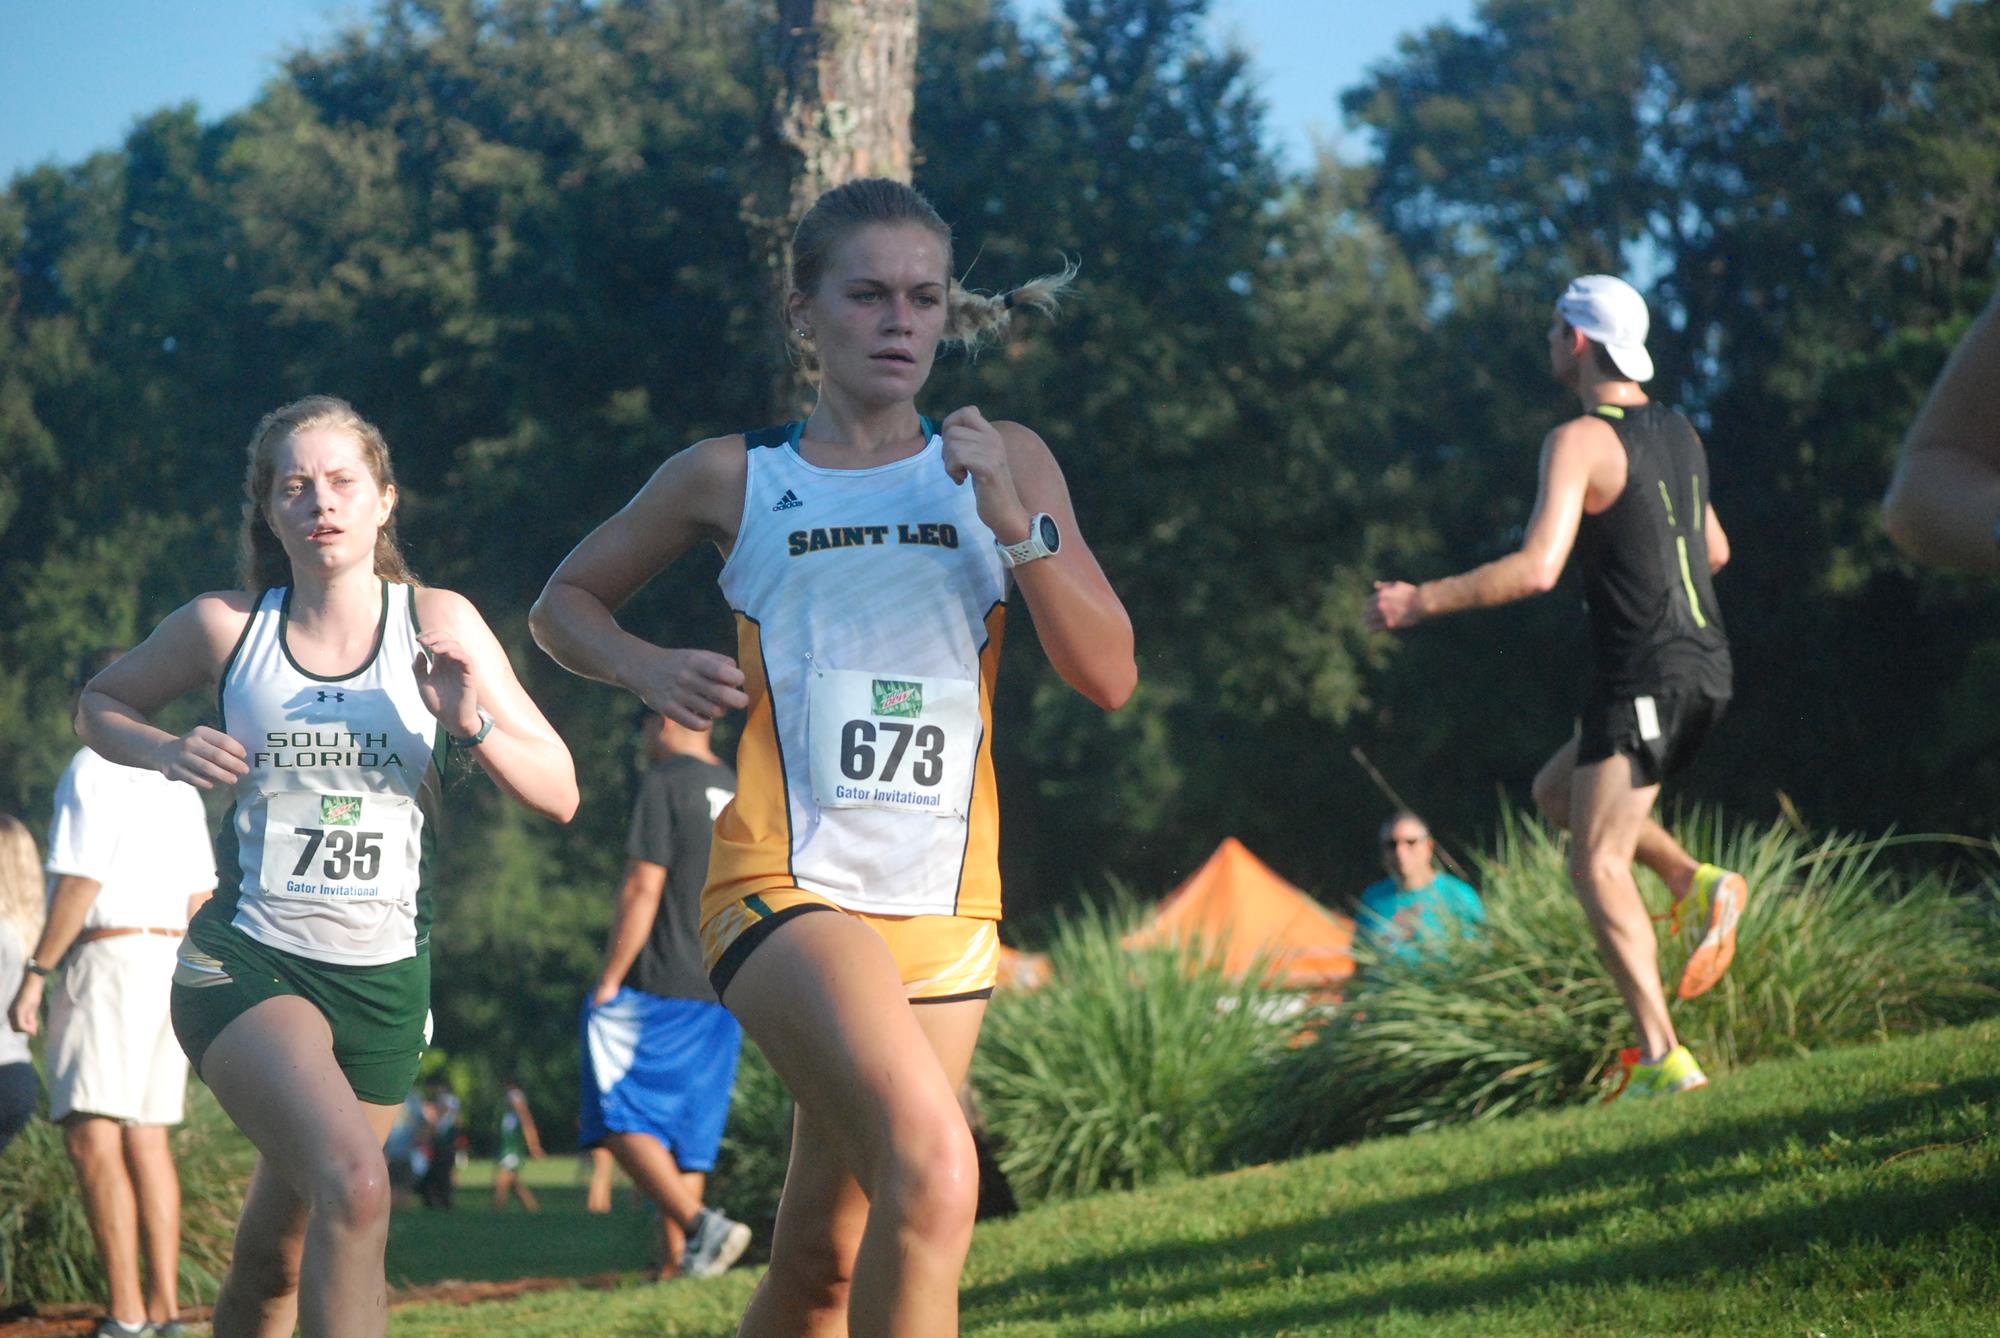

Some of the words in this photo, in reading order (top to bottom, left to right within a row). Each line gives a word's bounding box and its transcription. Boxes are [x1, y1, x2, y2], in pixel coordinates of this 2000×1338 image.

[772, 500, 803, 511] adidas
[788, 525, 888, 557] SAINT
[897, 523, 959, 549] LEO
[266, 732, 388, 748] SOUTH
[254, 752, 403, 768] FLORIDA
[840, 719, 945, 787] 673
[836, 785, 870, 800] Gator
[874, 788, 941, 806] Invitational
[292, 827, 384, 881] 735
[286, 880, 317, 894] Gator
[320, 884, 379, 896] Invitational
